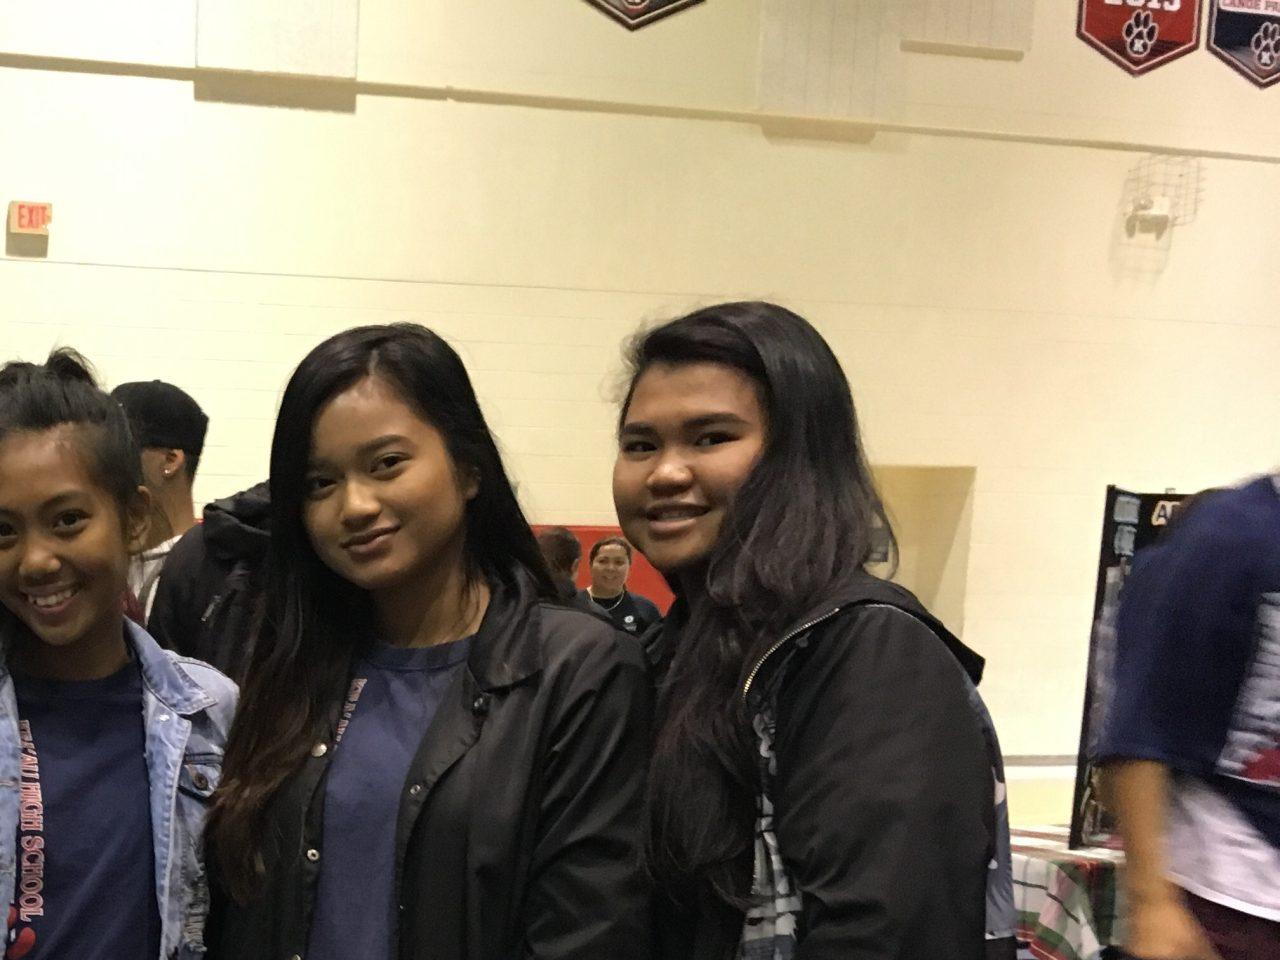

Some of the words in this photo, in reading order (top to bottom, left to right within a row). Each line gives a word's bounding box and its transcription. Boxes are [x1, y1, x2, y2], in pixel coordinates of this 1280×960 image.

[18, 204, 48, 229] EXIT
[20, 782, 43, 831] HIGH
[20, 835, 45, 922] SCHOOL
